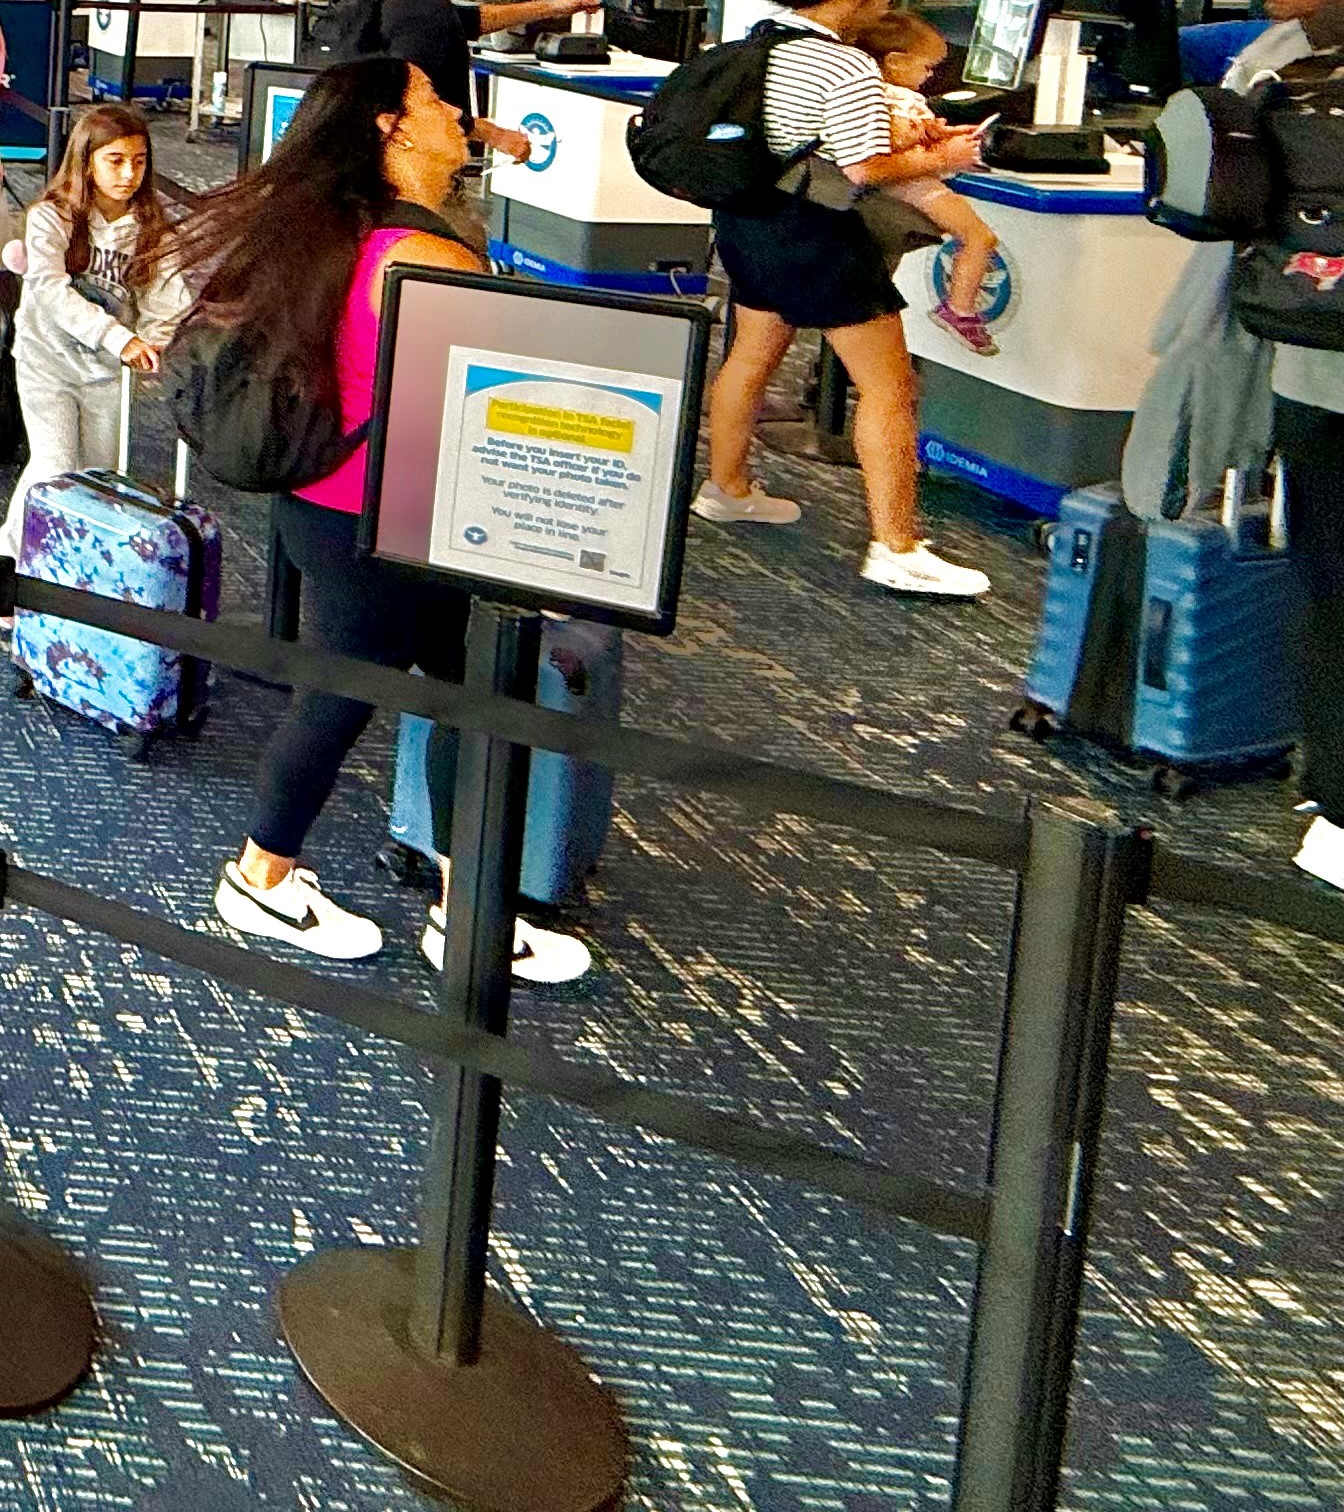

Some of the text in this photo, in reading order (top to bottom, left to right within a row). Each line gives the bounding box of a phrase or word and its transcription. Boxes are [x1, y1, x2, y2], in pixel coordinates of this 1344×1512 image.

[472, 446, 641, 482] advise the TSA officer if you do
[487, 437, 523, 452] Before
[526, 444, 546, 457] you
[549, 447, 580, 463] insert
[584, 453, 610, 466] your
[945, 452, 988, 478] IDEMIA
[481, 456, 500, 467] not
[502, 460, 529, 472] want
[531, 464, 556, 479] your
[559, 470, 592, 484] photo
[481, 475, 625, 509] Your photo is deleted after
[504, 490, 551, 507] verifying
[491, 506, 608, 536] You will not lose your
[514, 521, 543, 535] place
[546, 526, 555, 536] in
